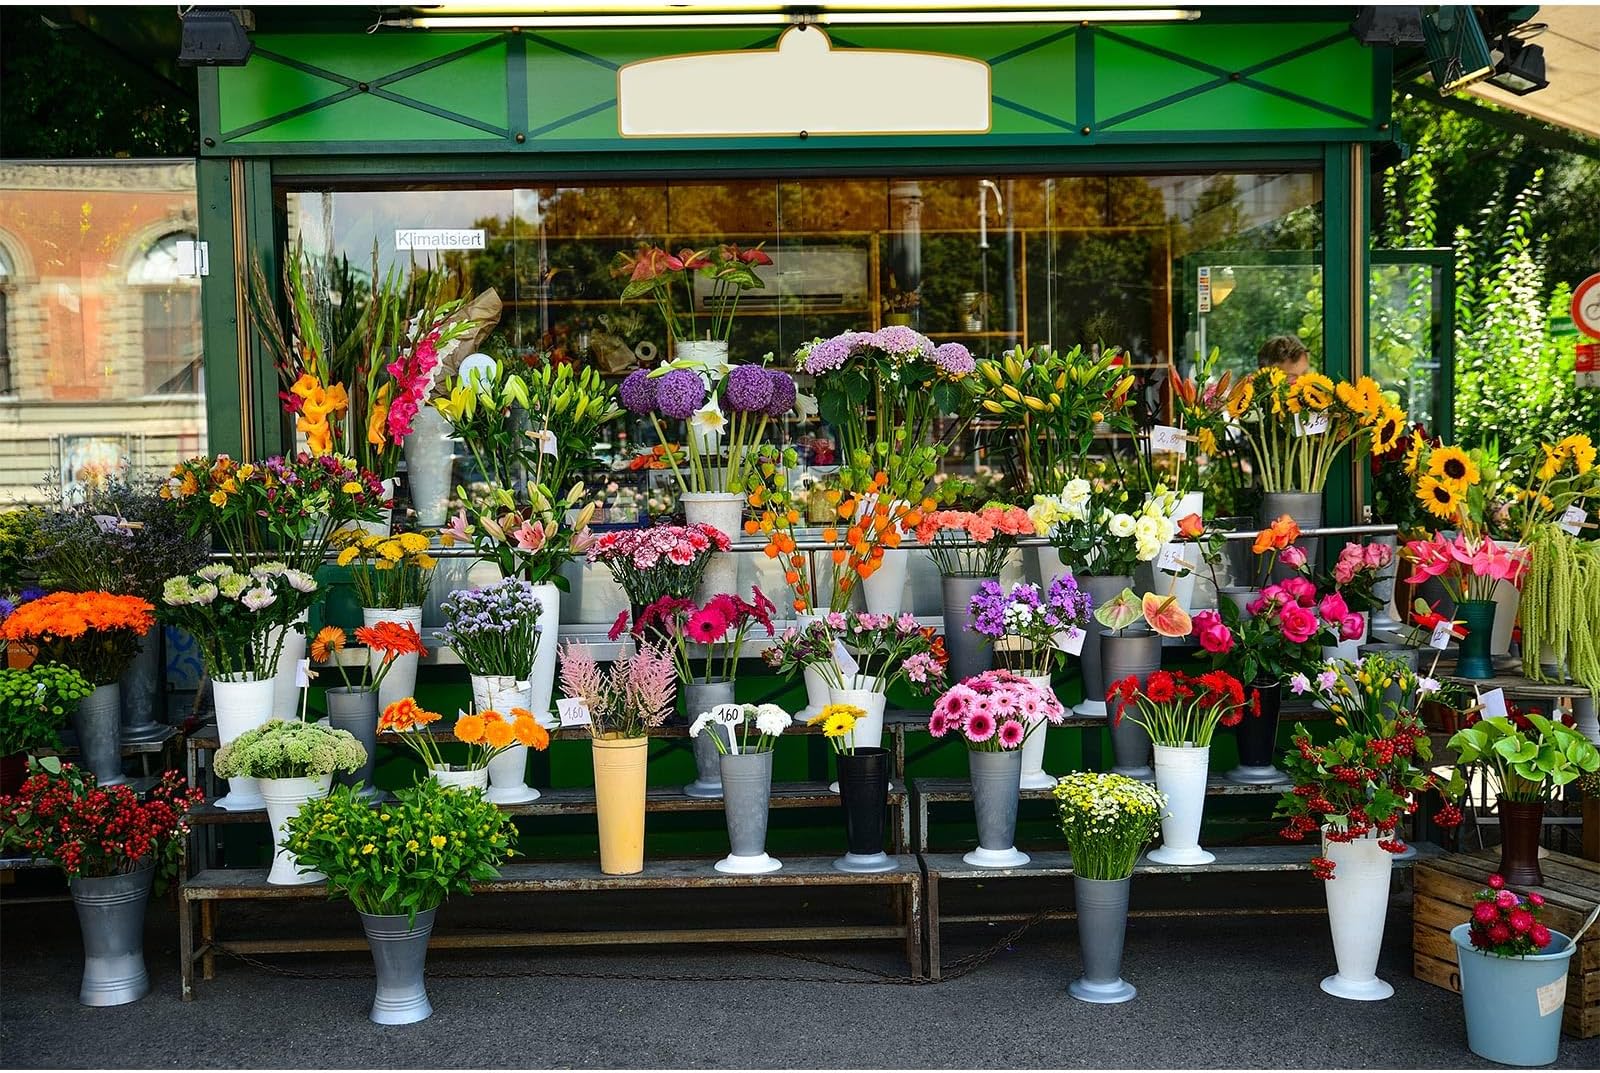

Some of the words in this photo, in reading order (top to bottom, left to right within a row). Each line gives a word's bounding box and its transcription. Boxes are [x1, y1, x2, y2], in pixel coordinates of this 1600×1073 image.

[398, 232, 482, 246] Klimatisiert
[563, 706, 584, 721] 1,60
[717, 707, 739, 723] 1,60
